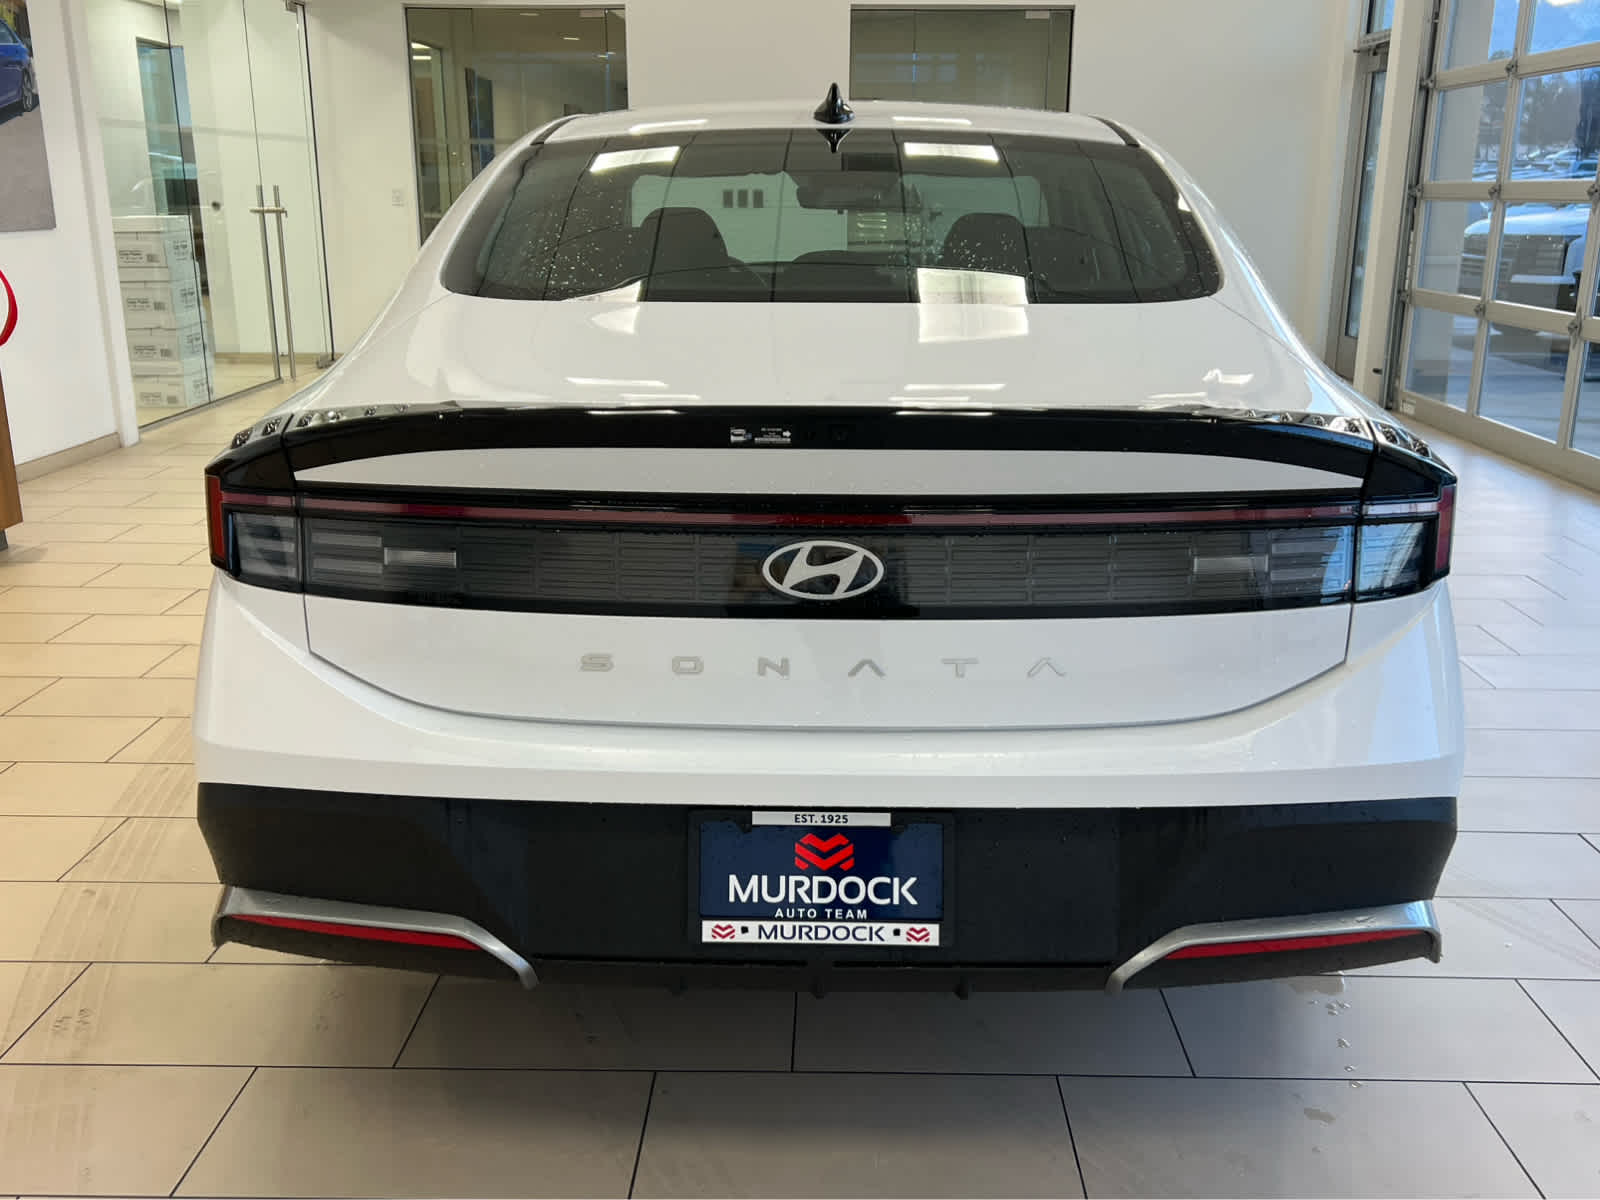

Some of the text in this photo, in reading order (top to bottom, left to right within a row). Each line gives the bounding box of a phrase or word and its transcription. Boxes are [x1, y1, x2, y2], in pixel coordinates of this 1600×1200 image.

[580, 653, 1067, 679] SONATA
[794, 813, 849, 824] EST. 1925
[728, 874, 919, 905] MURDOCK
[774, 907, 868, 920] AUTO TEAM
[757, 924, 886, 942] MURDOCK
